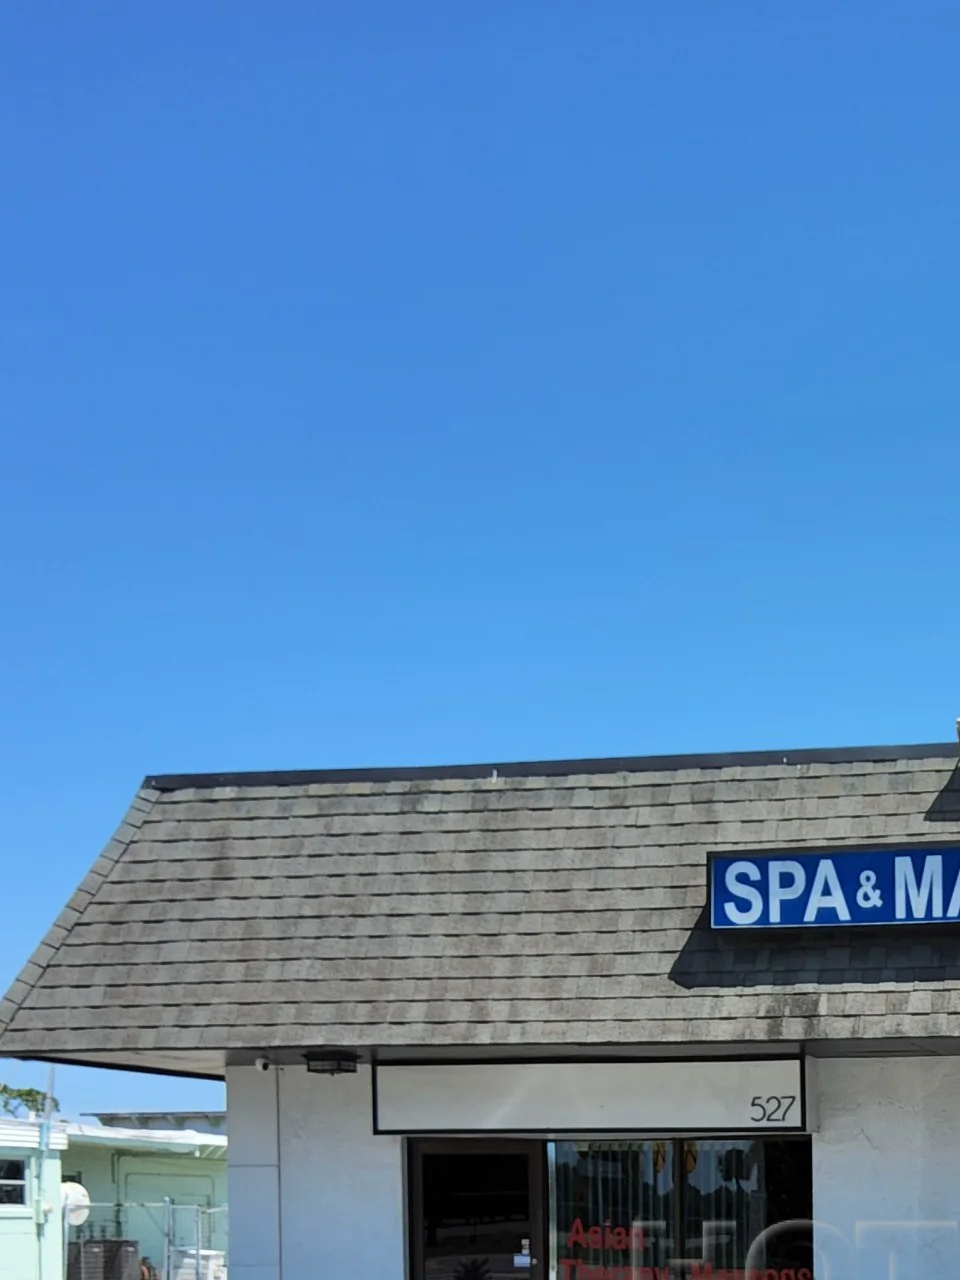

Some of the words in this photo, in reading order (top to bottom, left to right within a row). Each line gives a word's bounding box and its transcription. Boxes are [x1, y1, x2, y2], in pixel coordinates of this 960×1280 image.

[723, 858, 852, 925] SPA
[856, 869, 883, 908] &
[750, 1096, 796, 1122] 527
[567, 1217, 644, 1250] Asian
